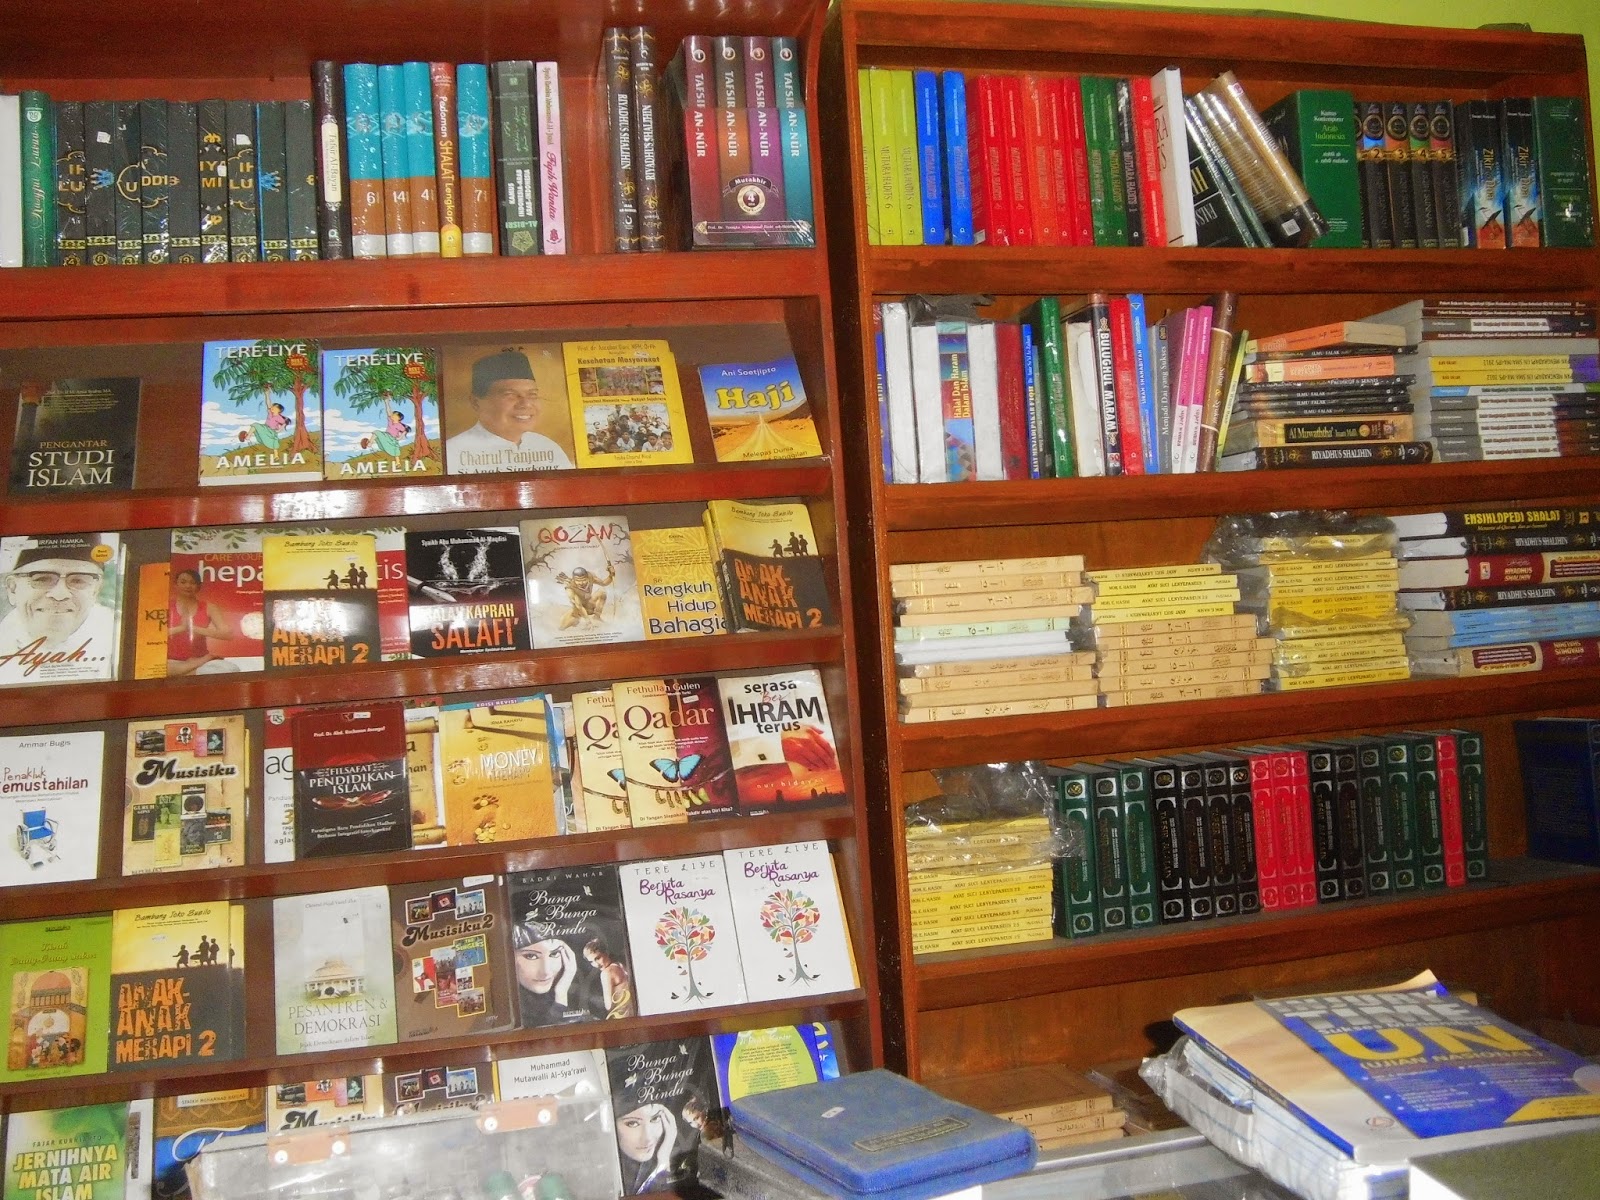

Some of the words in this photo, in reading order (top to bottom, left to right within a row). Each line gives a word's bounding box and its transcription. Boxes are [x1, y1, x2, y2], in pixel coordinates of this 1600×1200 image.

[439, 140, 455, 181] SHALAT
[366, 191, 376, 204] 6
[392, 190, 406, 202] 14
[420, 189, 430, 201] 4
[475, 189, 483, 201] 7
[215, 344, 308, 360] TERE-LIYE
[335, 352, 424, 367] TERE-LIYE
[1101, 332, 1113, 385] BULUGHUL
[1160, 346, 1168, 370] Sukses
[721, 369, 736, 377] Ani
[1161, 371, 1170, 389] yang
[715, 380, 796, 411] Haji
[1161, 390, 1169, 404] Dai
[1105, 390, 1117, 430] MARAM
[1162, 405, 1170, 436] Menjadi
[40, 440, 108, 449] PENGANTAR
[742, 449, 772, 459] Melepas
[773, 446, 794, 454] Dunia
[28, 449, 116, 467] STUDI
[216, 452, 306, 469] AMELIA
[460, 449, 502, 466] Chairul
[505, 449, 555, 464] Tanjung
[340, 459, 427, 475] AMELIA
[26, 466, 114, 487] ISLAM
[1463, 511, 1525, 525] ENSIKLOPEDI
[1527, 509, 1560, 521] SHALAT
[537, 523, 615, 546] QOZAN
[204, 553, 232, 562] CARE
[644, 580, 713, 598] Rengkuh
[466, 603, 515, 618] KAPRAH
[667, 599, 717, 613] Hidup
[743, 602, 803, 630] MERAPI
[806, 607, 823, 628] 2
[272, 645, 345, 667] MERAPI
[351, 642, 370, 664] 2
[626, 683, 671, 695] Fethullah
[744, 680, 798, 694] serasa
[728, 696, 825, 726] IHRAM
[623, 702, 715, 741] Qadar
[756, 720, 801, 734] terus
[480, 747, 538, 770] MONEY
[4, 765, 47, 782] Penakluk
[135, 757, 236, 786] Musisiku
[329, 764, 372, 776] FILSAFAT
[0, 776, 89, 794] emustahilan
[309, 771, 394, 788] PENDIDIKAN
[332, 782, 372, 795] ISLAM
[738, 848, 774, 859] TERE
[634, 864, 670, 877] TERE
[743, 859, 789, 878] Berjuta
[639, 876, 685, 896] Berjuta
[768, 869, 820, 888] Rasanya
[529, 889, 581, 907] Bunga
[664, 888, 716, 906] Rasanya
[544, 904, 598, 922] Bunga
[401, 921, 481, 947] Musisiku
[538, 921, 587, 938] Rindu
[289, 999, 377, 1020] PESANTREN
[379, 997, 388, 1009] &
[605, 988, 632, 1020] 2
[116, 1003, 192, 1037] ANAK
[294, 1014, 381, 1036] DEMOKRASI
[115, 1033, 193, 1064] MERAPI
[198, 1029, 218, 1057] 2
[1324, 1025, 1535, 1061] UN
[530, 1058, 571, 1072] Muhammad
[626, 1054, 678, 1072] Bunga
[513, 1072, 549, 1083] Mutawalli
[550, 1066, 588, 1080] Al-Sya'rawi
[643, 1068, 694, 1087] Bunga
[637, 1083, 684, 1104] Rindu
[13, 1144, 118, 1172] JERNIHNYA
[18, 1167, 73, 1190] MATA
[78, 1162, 112, 1183] AIR
[35, 1183, 93, 1200] ISLAM
